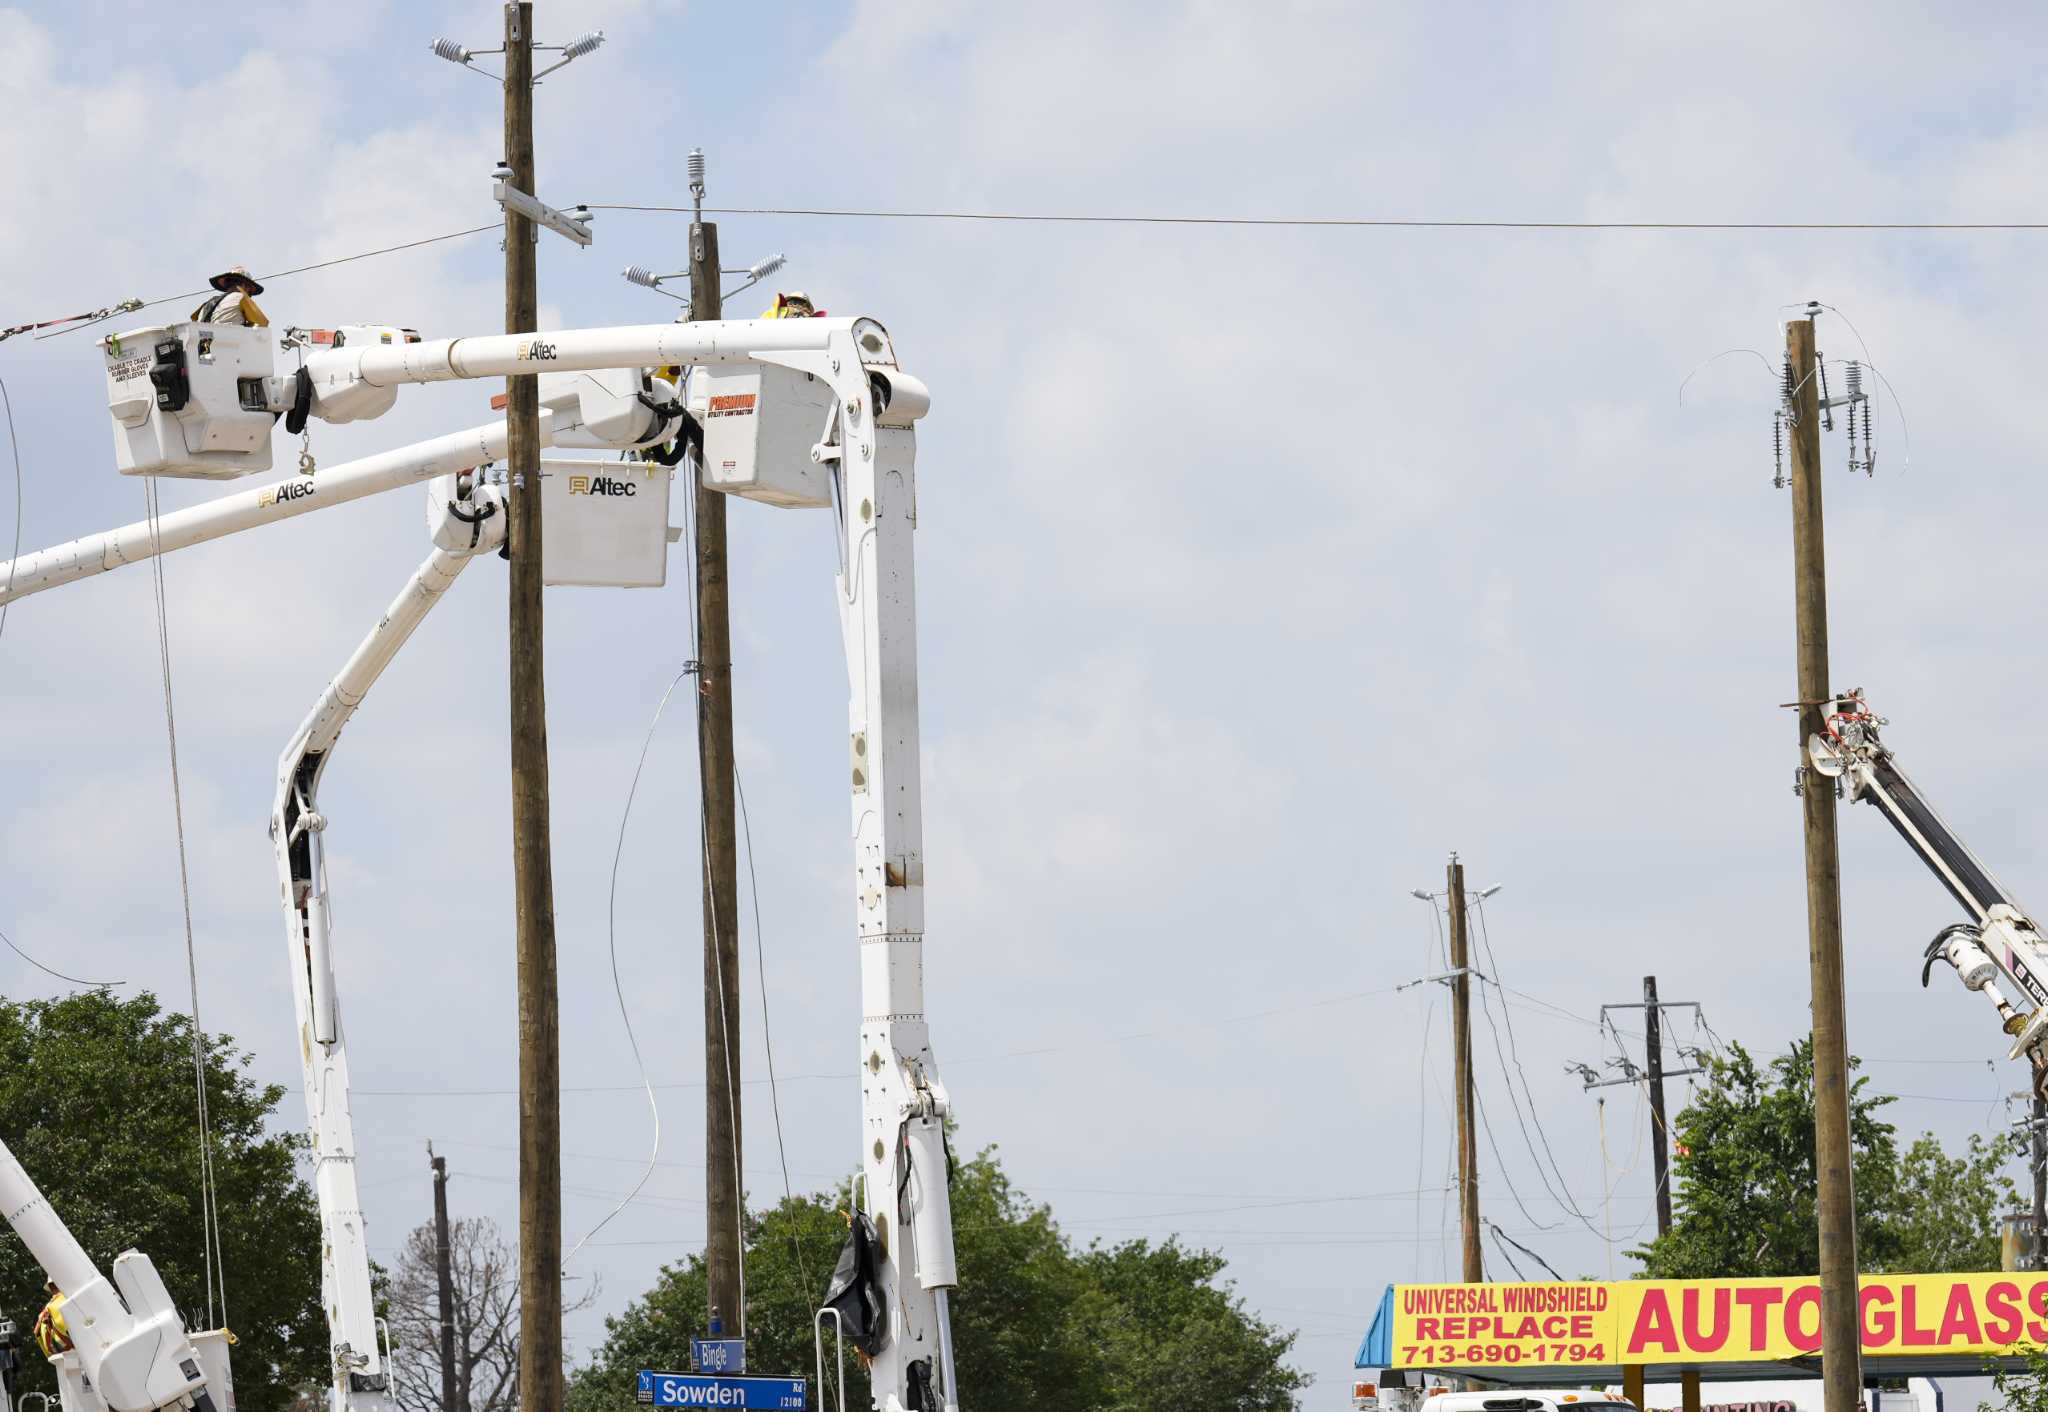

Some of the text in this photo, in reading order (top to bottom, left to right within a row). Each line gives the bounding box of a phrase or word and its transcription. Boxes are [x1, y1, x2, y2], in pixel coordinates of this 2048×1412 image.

[529, 340, 557, 360] Altec
[115, 370, 146, 383] AND SLEEVES
[131, 363, 149, 373] GLOVES
[708, 408, 754, 419] UTILITY CONTRACTOR
[276, 481, 314, 504] Altec
[589, 477, 636, 497] Altec
[1404, 1287, 1608, 1315] UNIVERSAL WINDSHIELD
[1416, 1315, 1593, 1340] REPLACE
[1627, 1281, 2048, 1354] AUTO GLASS
[701, 1344, 727, 1370] Bingle
[1402, 1343, 1606, 1364] 713-690-1794
[662, 1380, 745, 1405] Sowden
[792, 1383, 803, 1393] Rd
[780, 1396, 802, 1408] 12100
